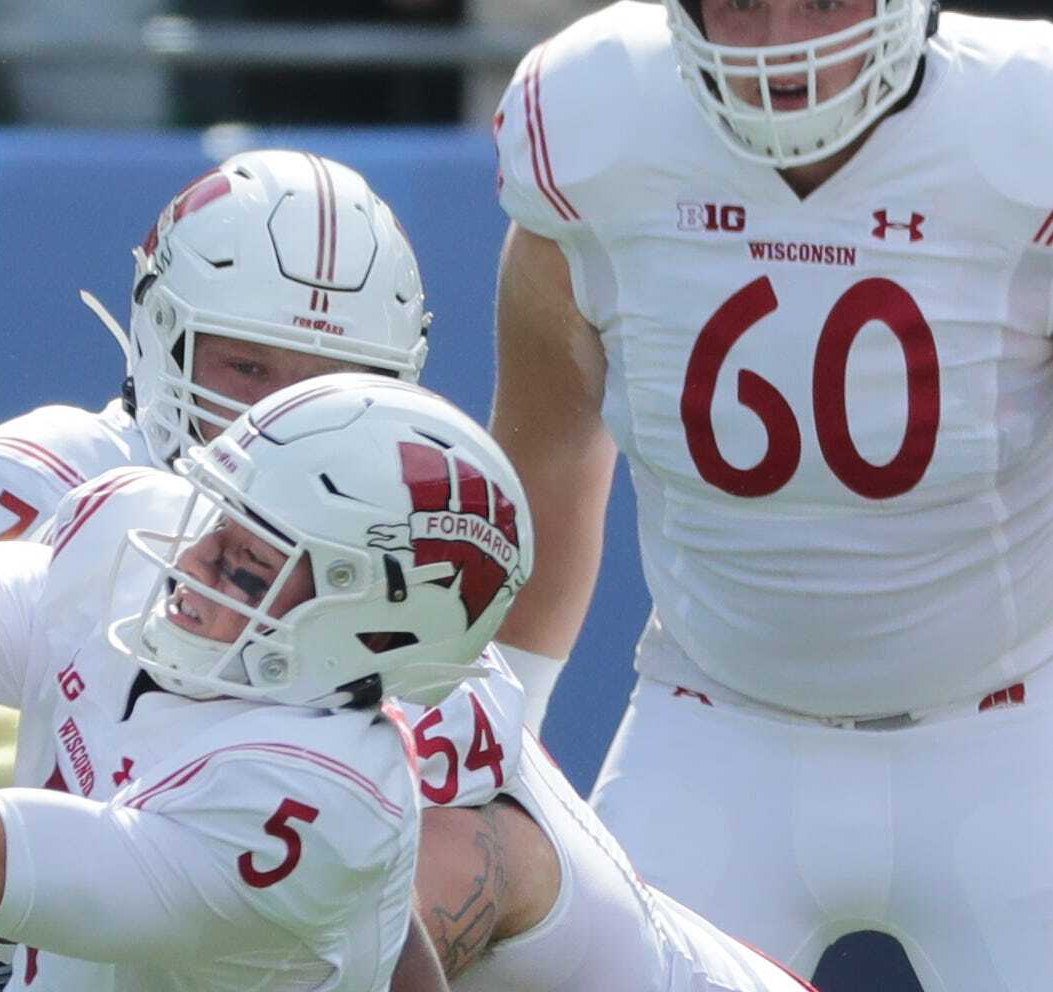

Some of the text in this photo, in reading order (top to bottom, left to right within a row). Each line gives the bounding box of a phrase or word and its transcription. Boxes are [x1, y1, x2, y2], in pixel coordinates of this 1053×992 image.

[749, 241, 857, 266] WISCONSIN
[681, 274, 941, 500] 60
[426, 515, 513, 563] FORWARD
[412, 691, 505, 805] 54
[237, 797, 319, 889] 5
